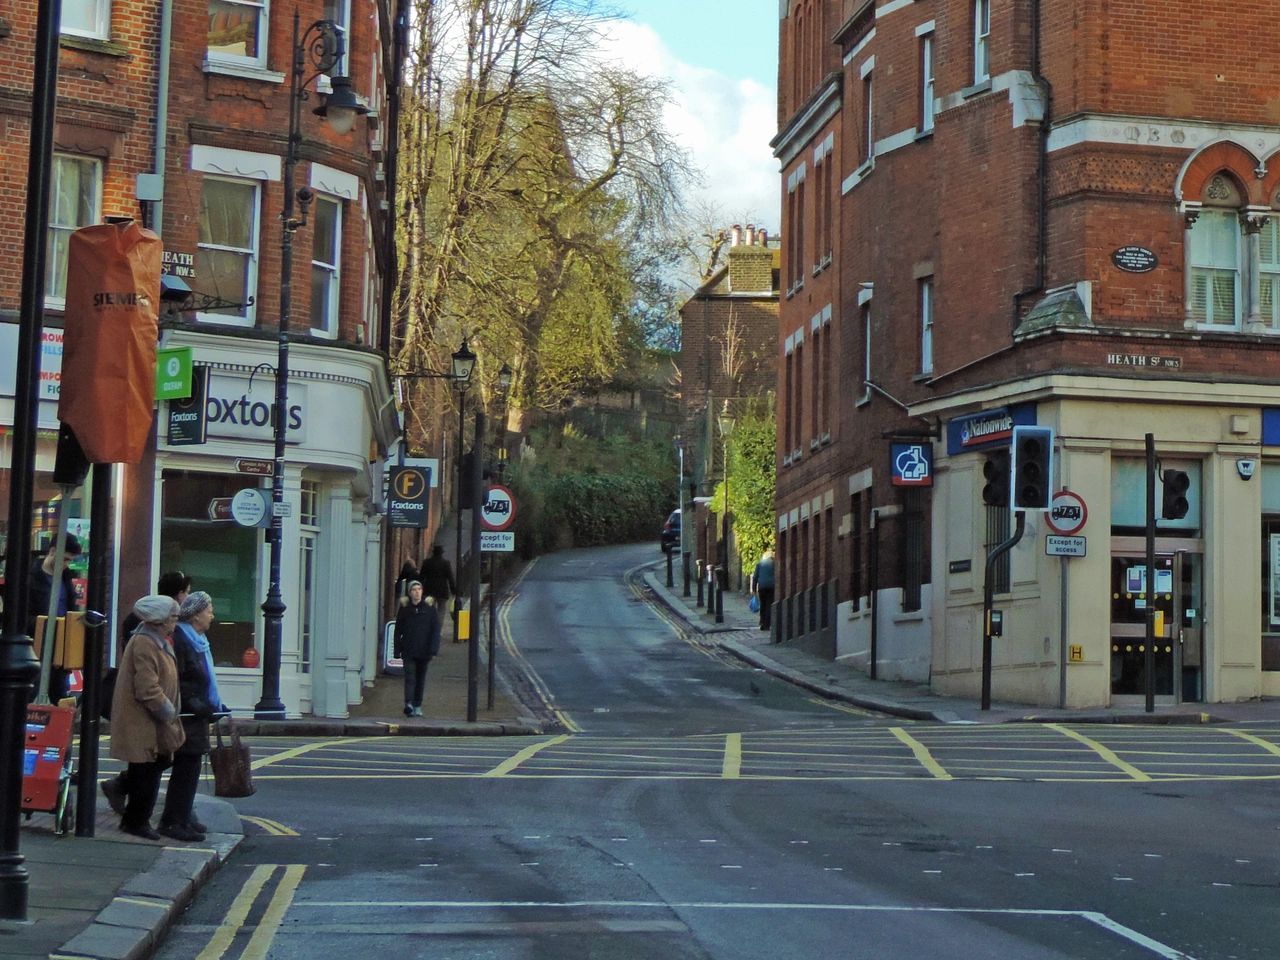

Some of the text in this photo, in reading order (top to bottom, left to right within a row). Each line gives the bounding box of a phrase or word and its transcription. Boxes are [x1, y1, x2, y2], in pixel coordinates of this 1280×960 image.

[94, 292, 150, 306] SIEME
[1107, 354, 1146, 366] HEATH
[170, 411, 198, 423] Foxtons
[207, 393, 303, 430] oxtos
[969, 415, 1013, 437] Nationwide
[391, 500, 424, 510] Foxtons
[480, 533, 512, 542] xcept for
[1049, 538, 1072, 546] Except
